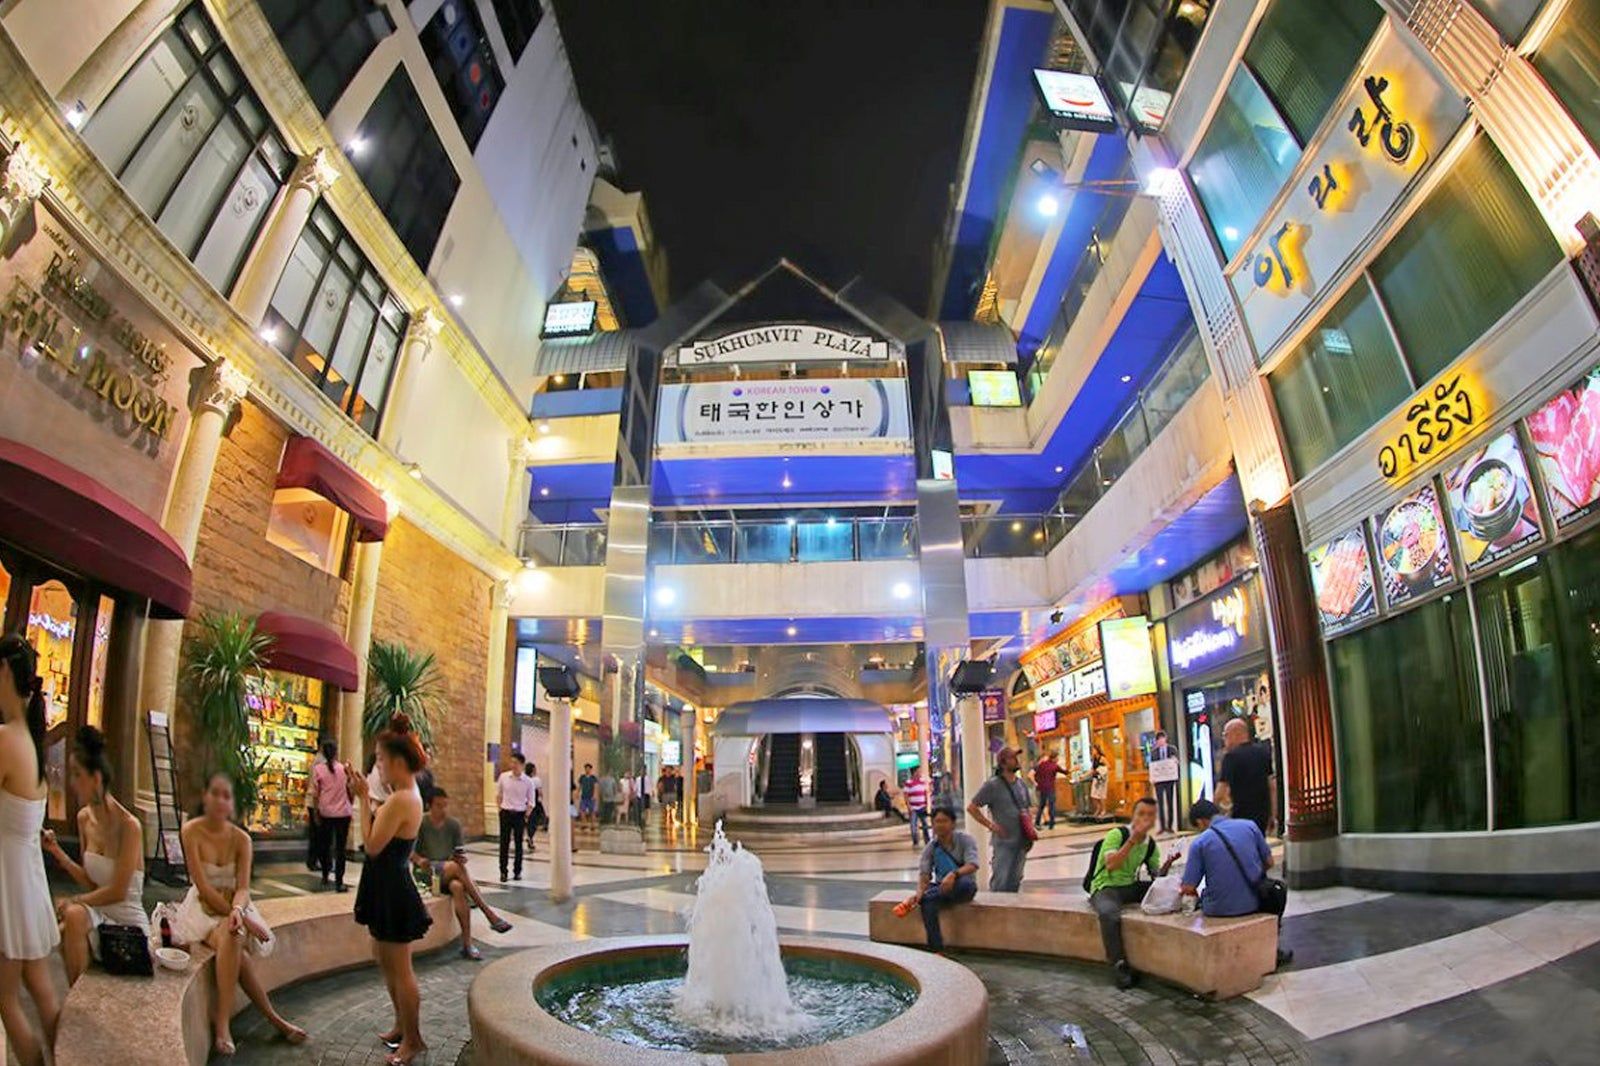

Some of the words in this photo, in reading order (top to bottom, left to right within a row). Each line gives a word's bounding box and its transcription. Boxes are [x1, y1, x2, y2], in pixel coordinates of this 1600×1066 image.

[694, 329, 803, 362] SUKHUMVIT
[813, 331, 871, 358] PLAZA
[83, 350, 178, 442] MOON
[747, 385, 786, 396] KOREAN
[789, 384, 818, 395] TOWN
[699, 399, 864, 423] 태국한인상가
[1378, 374, 1473, 478] อารีรัง
